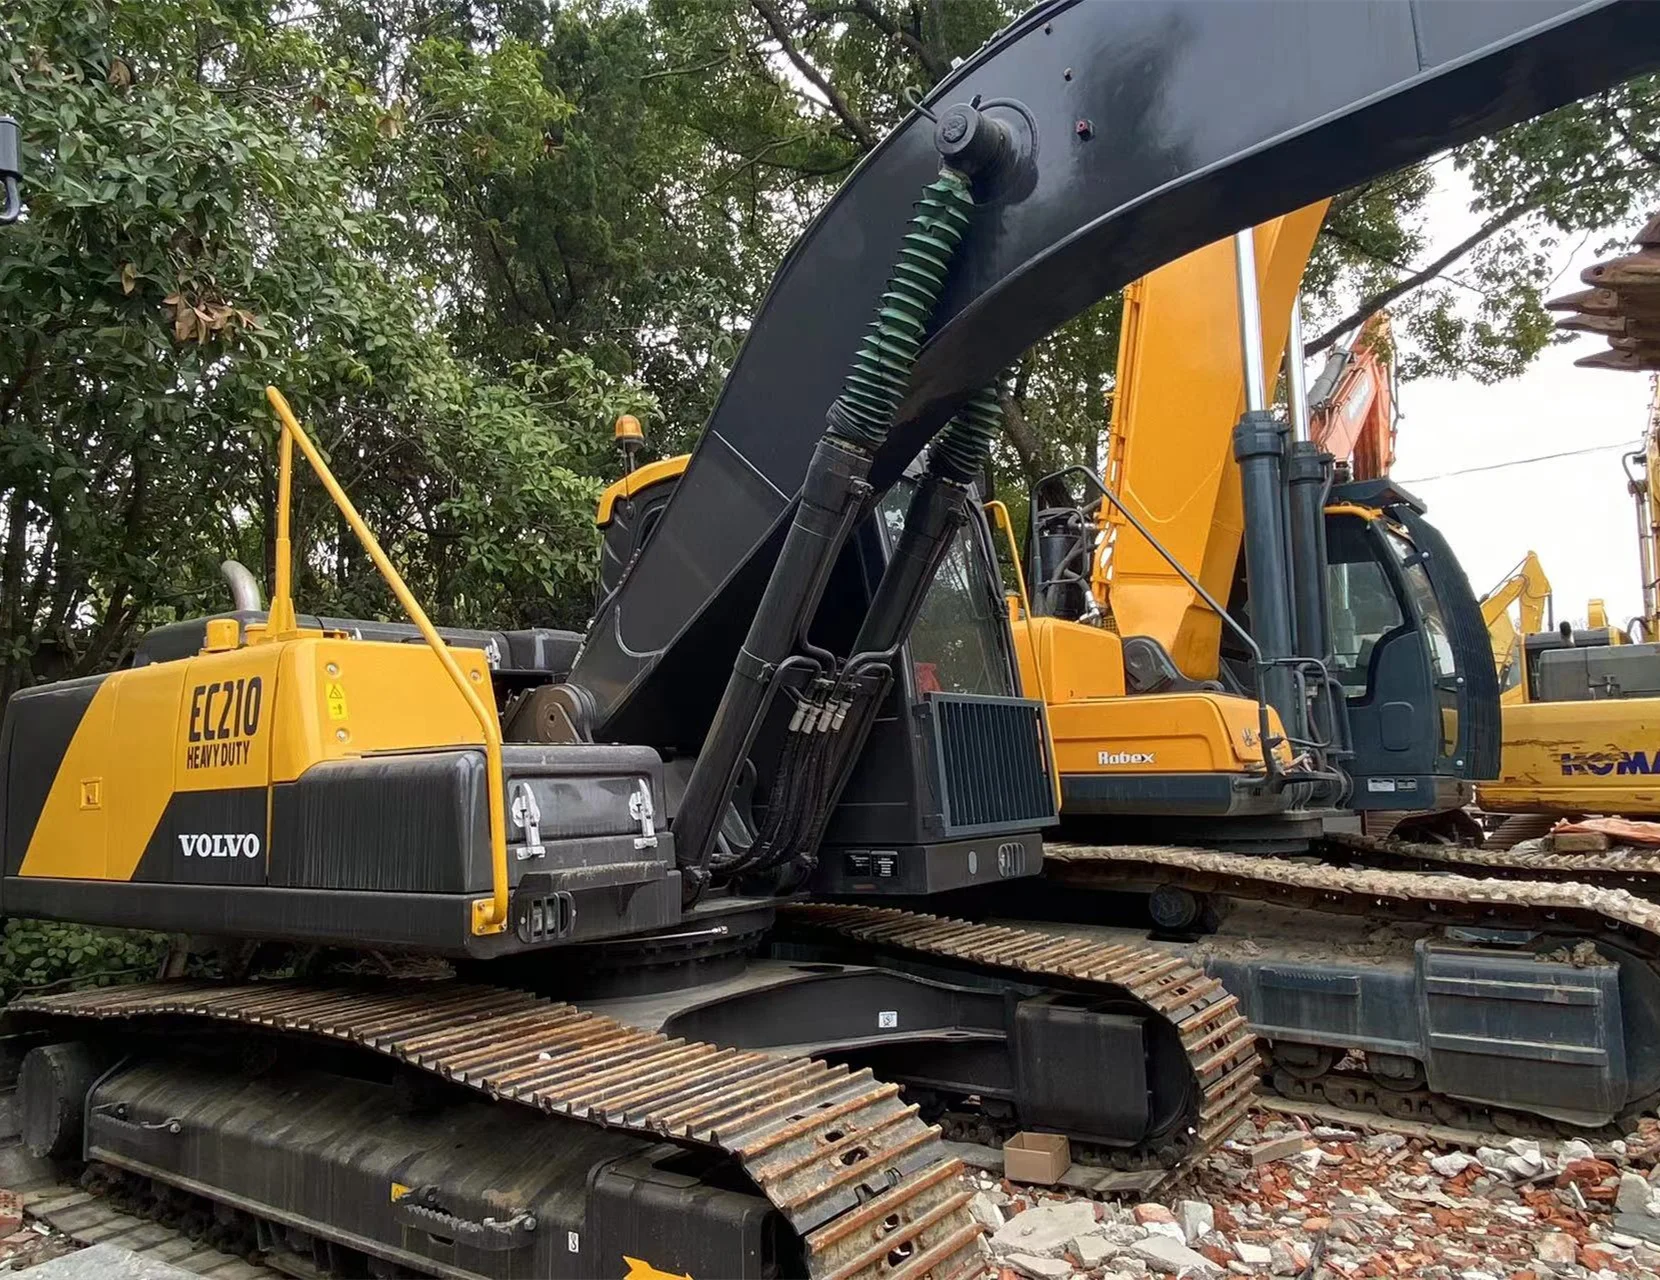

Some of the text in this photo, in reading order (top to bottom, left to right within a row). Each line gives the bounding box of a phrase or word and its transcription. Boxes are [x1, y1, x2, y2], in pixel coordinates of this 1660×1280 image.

[189, 676, 262, 742] EC210
[187, 740, 250, 769] HEAVY DUTY
[178, 833, 260, 858] VOLVO
